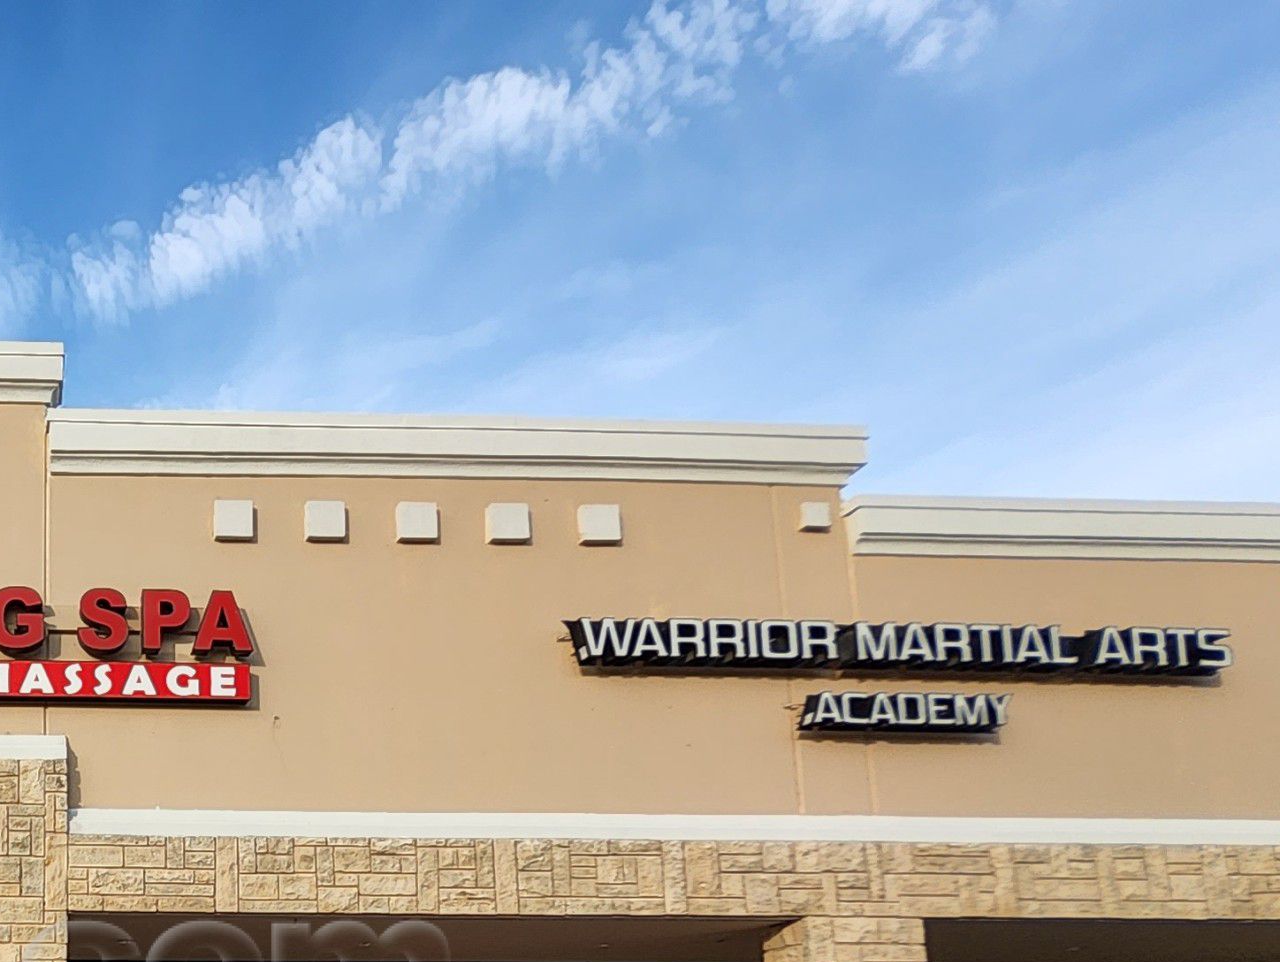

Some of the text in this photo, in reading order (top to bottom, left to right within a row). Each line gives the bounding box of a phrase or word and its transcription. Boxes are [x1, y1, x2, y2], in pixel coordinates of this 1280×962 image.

[76, 587, 254, 657] SPA
[582, 617, 1234, 671] WARRIOR MARTIAL ARTS
[814, 692, 1013, 727] ACADEMY
